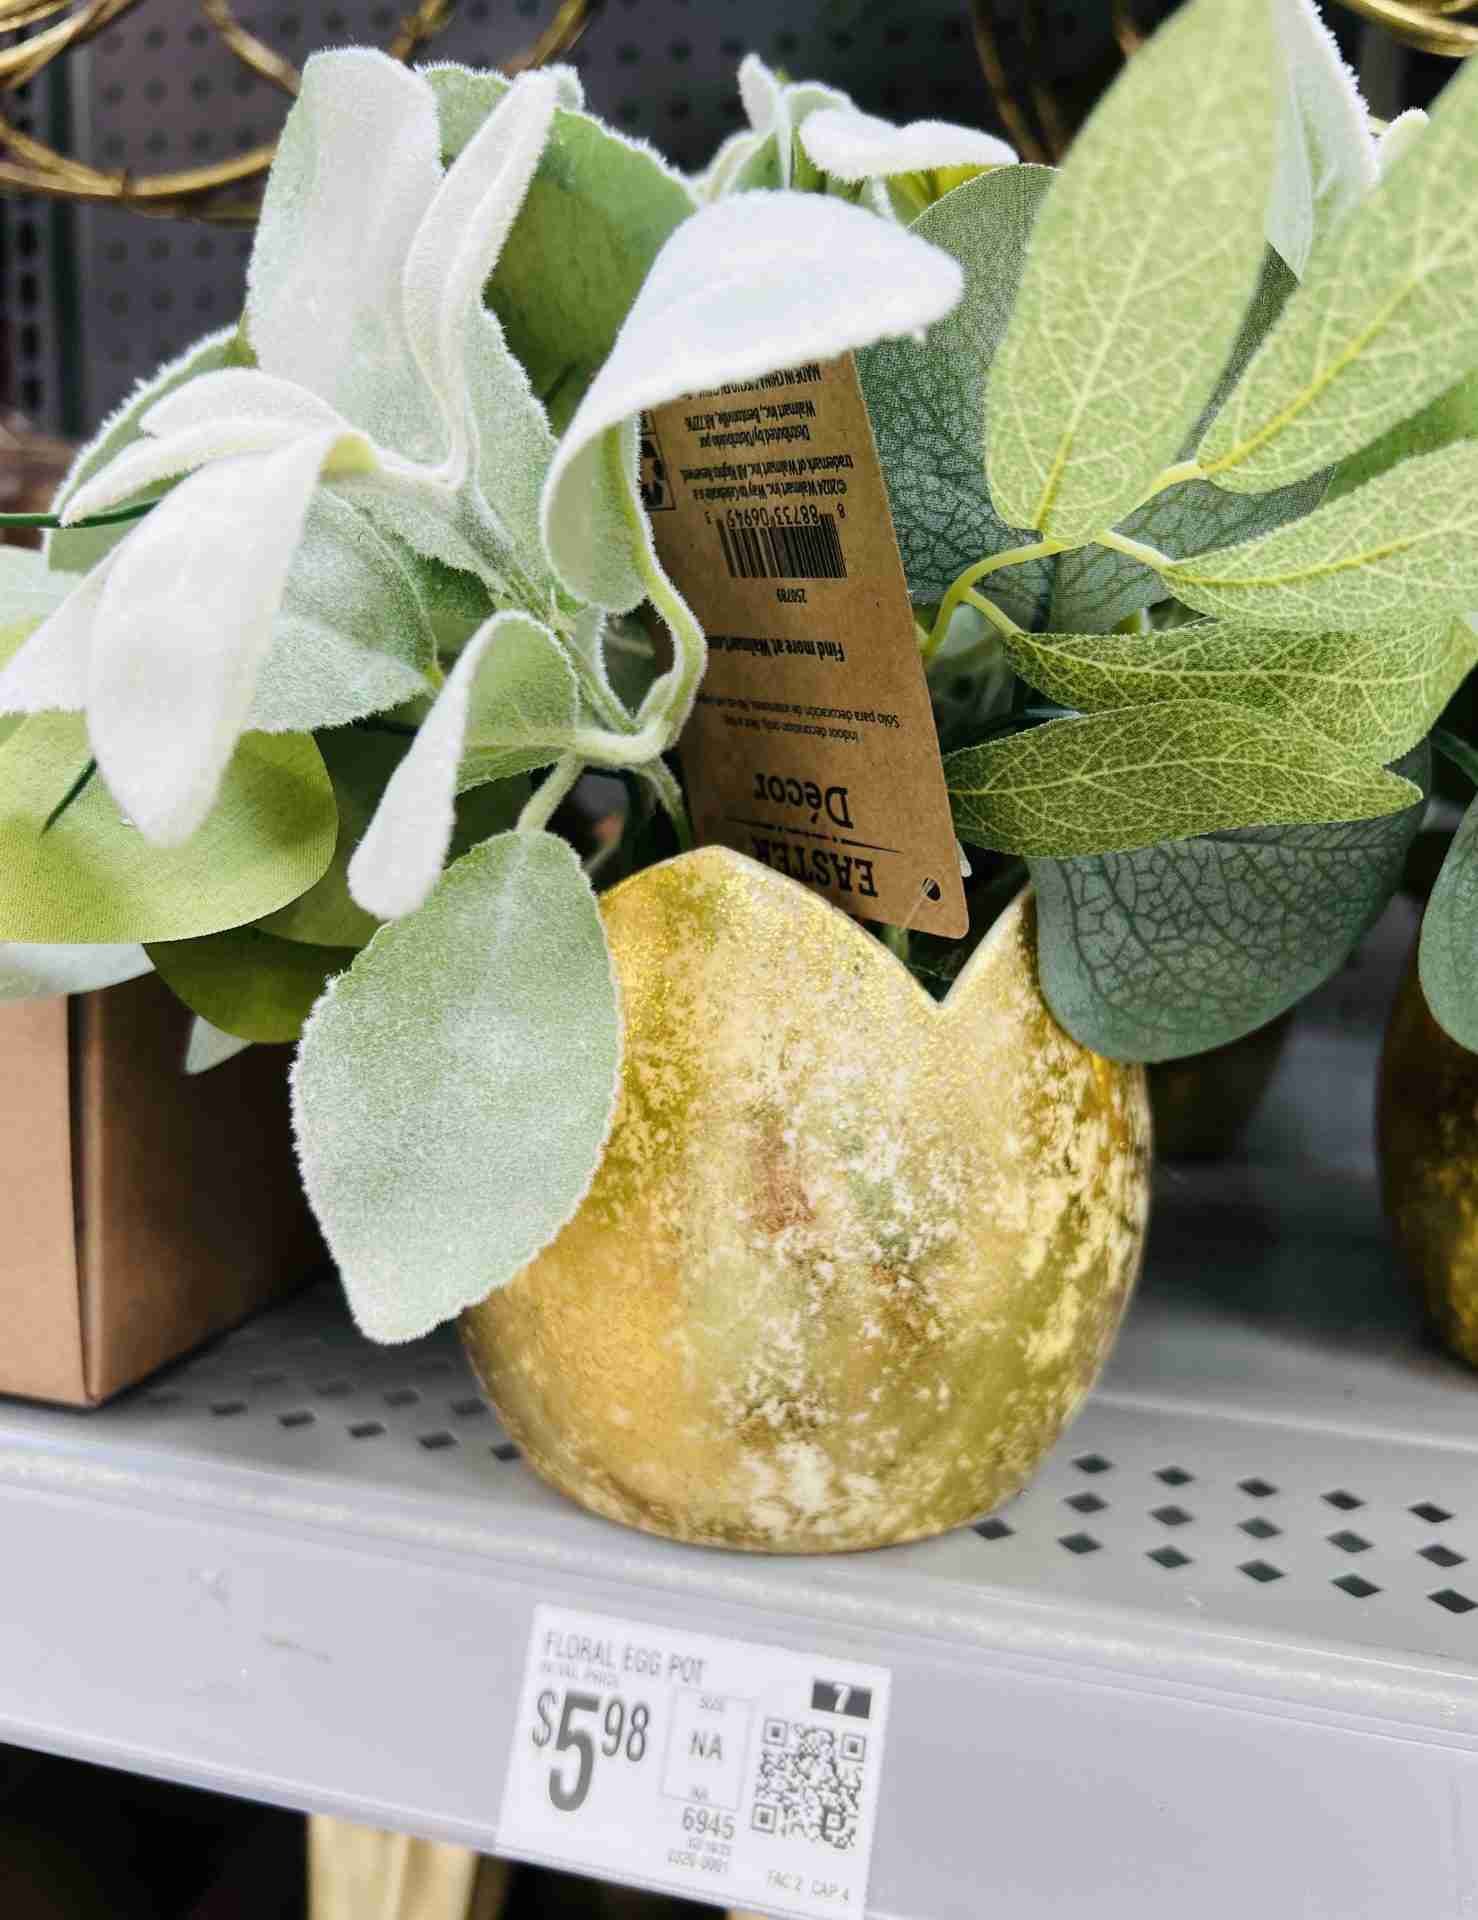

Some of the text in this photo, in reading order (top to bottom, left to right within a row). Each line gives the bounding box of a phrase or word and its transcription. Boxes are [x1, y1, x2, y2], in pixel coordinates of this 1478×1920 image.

[776, 400, 816, 419] Walmart
[766, 424, 810, 446] Distributed
[761, 456, 799, 477] Walmart
[798, 456, 808, 475] of
[808, 453, 853, 473] trademark
[748, 480, 769, 499] Way
[781, 479, 819, 499] Walmart
[836, 501, 847, 520] 8
[771, 639, 785, 655] at
[784, 639, 817, 656] more
[815, 640, 845, 662] Find
[853, 709, 877, 723] para
[784, 720, 829, 738] decoration
[829, 727, 858, 743] Indoor
[752, 772, 854, 829] Décor
[545, 1631, 616, 1669] FLORAL
[623, 1644, 663, 1676] EGG
[668, 1652, 708, 1684] POT
[833, 1682, 849, 1714] 7
[688, 1729, 723, 1761] NA
[682, 1806, 735, 1841] 6945
